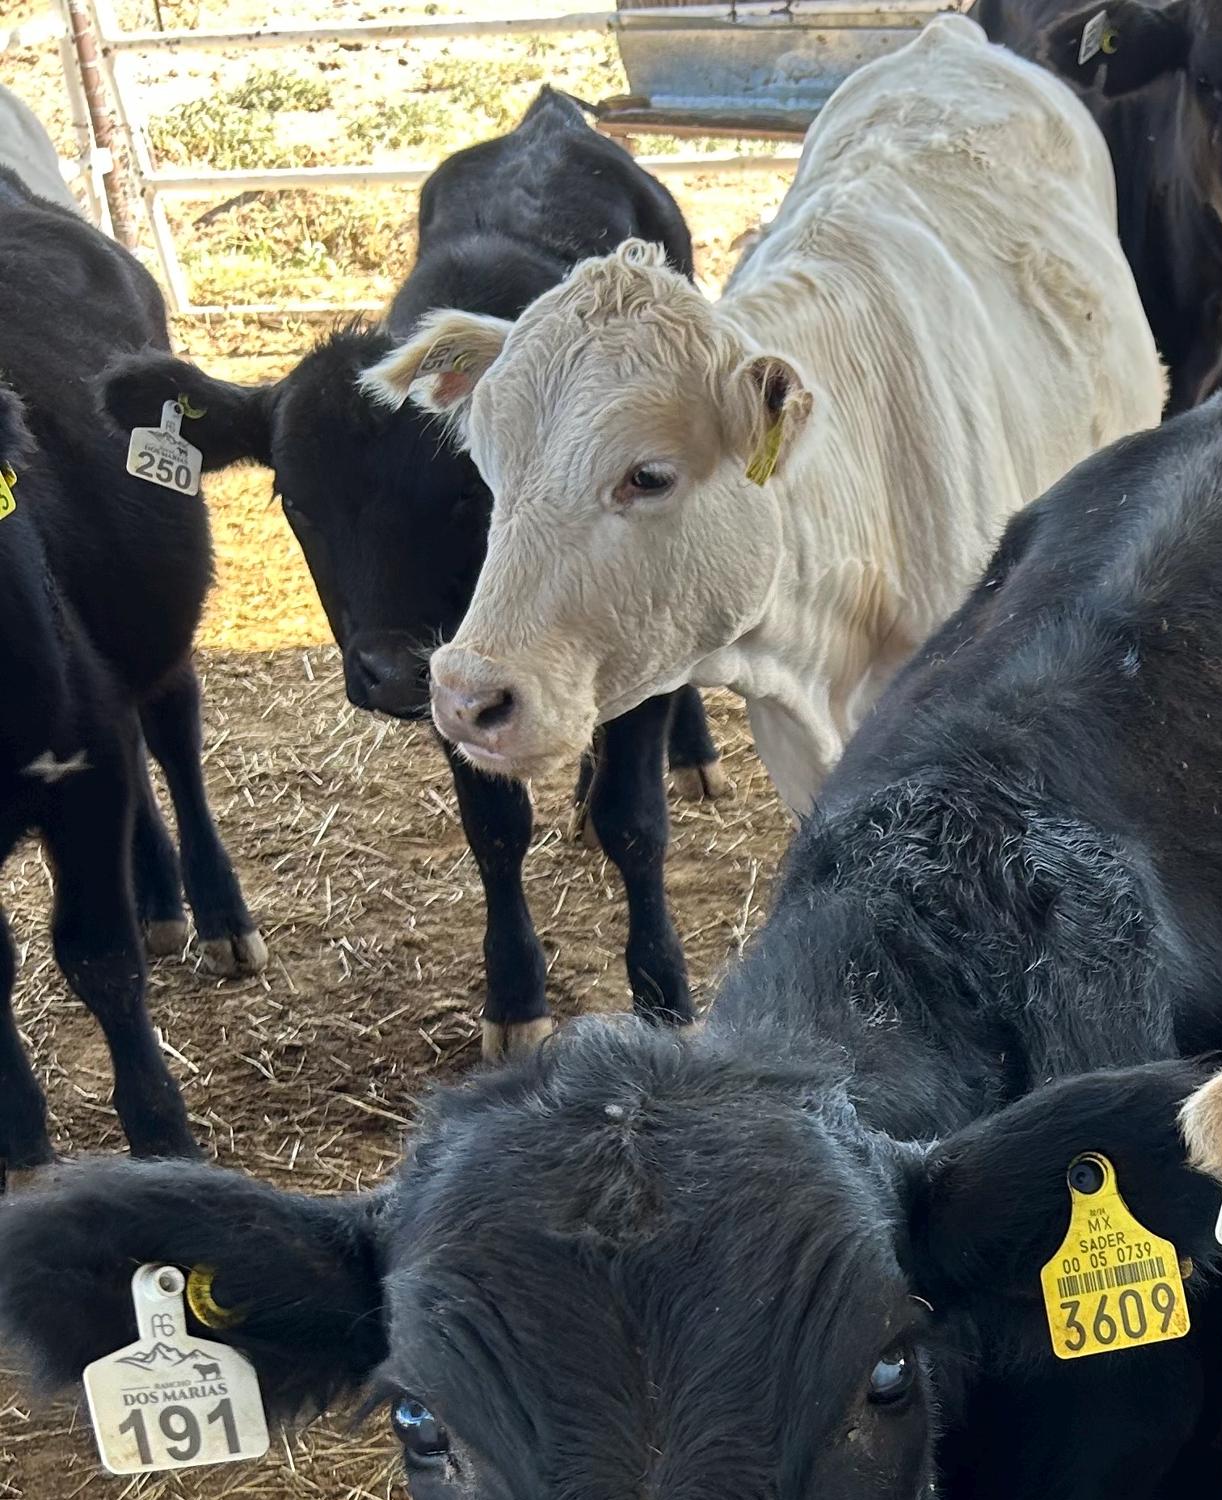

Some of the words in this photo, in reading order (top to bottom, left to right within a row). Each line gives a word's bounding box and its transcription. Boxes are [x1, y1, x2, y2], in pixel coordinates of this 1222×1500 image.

[136, 451, 192, 490] 250
[1088, 1215, 1112, 1233] MX
[1063, 1258, 1080, 1274] 00
[1090, 1251, 1107, 1268] 05
[1117, 1242, 1152, 1263] 0739
[1079, 1231, 1126, 1254] SADER
[1060, 1282, 1175, 1350] 3609
[123, 1392, 159, 1406] DOS
[162, 1383, 228, 1402] MARIAS
[119, 1398, 241, 1465] 191
